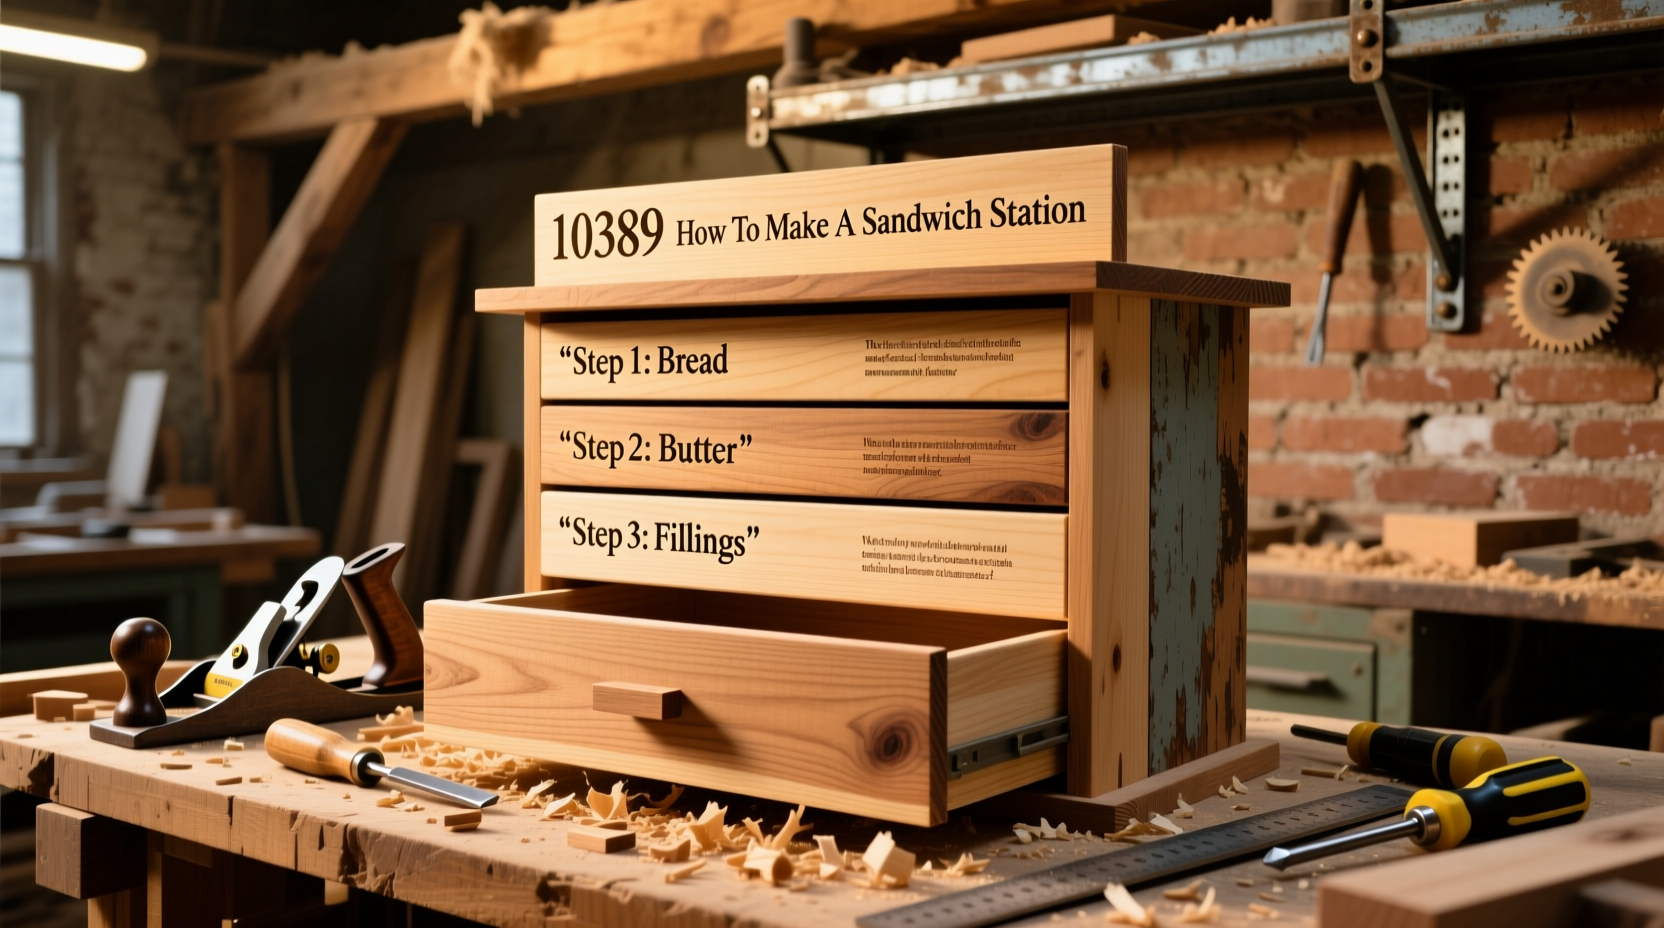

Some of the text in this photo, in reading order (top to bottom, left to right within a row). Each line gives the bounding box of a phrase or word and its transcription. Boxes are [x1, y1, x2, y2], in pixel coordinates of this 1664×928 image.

[553, 194, 1087, 260] 10389 How To Make A Sandwich Station
[559, 342, 729, 384] “Step 1: Bread
[559, 430, 753, 469] “Step 2: Butter”
[559, 515, 760, 565] “Step 3: Fillings”
